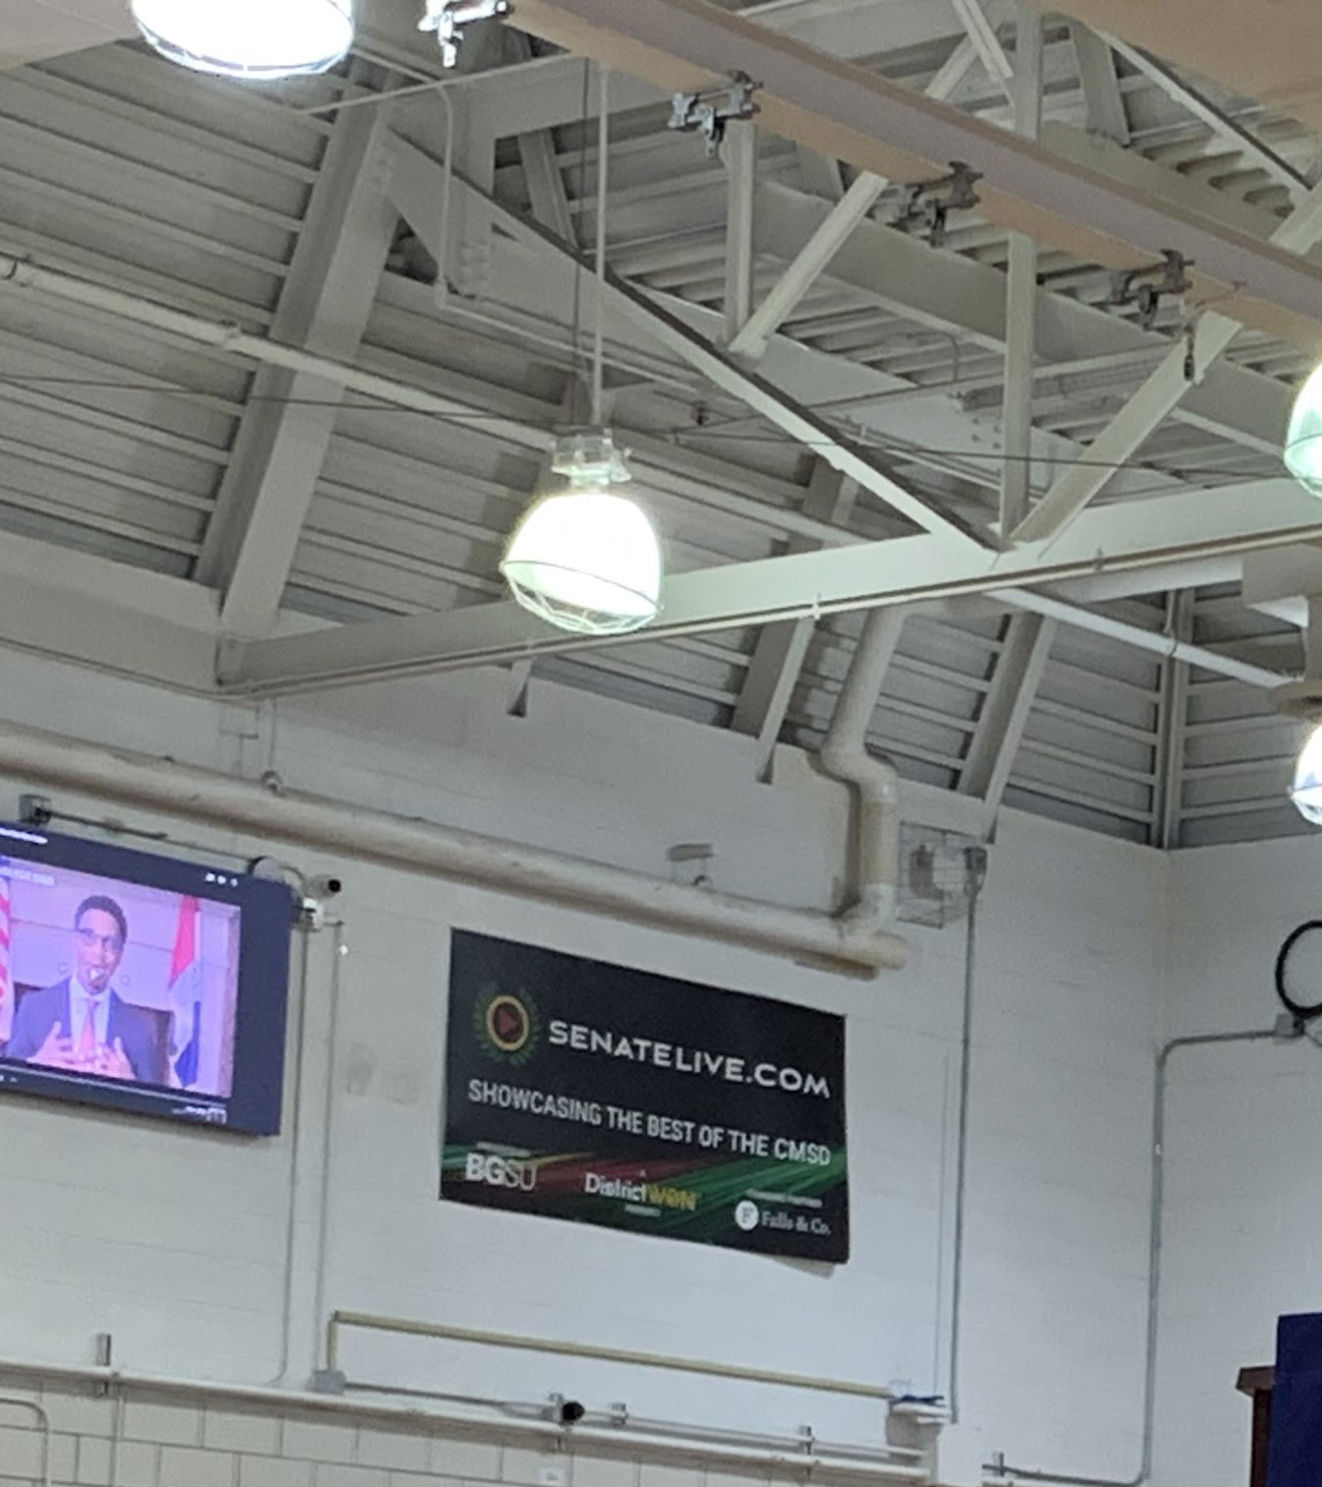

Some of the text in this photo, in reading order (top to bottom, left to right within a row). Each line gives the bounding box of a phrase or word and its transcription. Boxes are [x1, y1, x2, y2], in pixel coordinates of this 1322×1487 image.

[547, 1019, 832, 1099] SENATELIVE.COM
[467, 1078, 832, 1167] SHOWCASING THE BEST OF THE CMSD
[464, 1152, 539, 1192] BGSU
[760, 1210, 793, 1231] Falls
